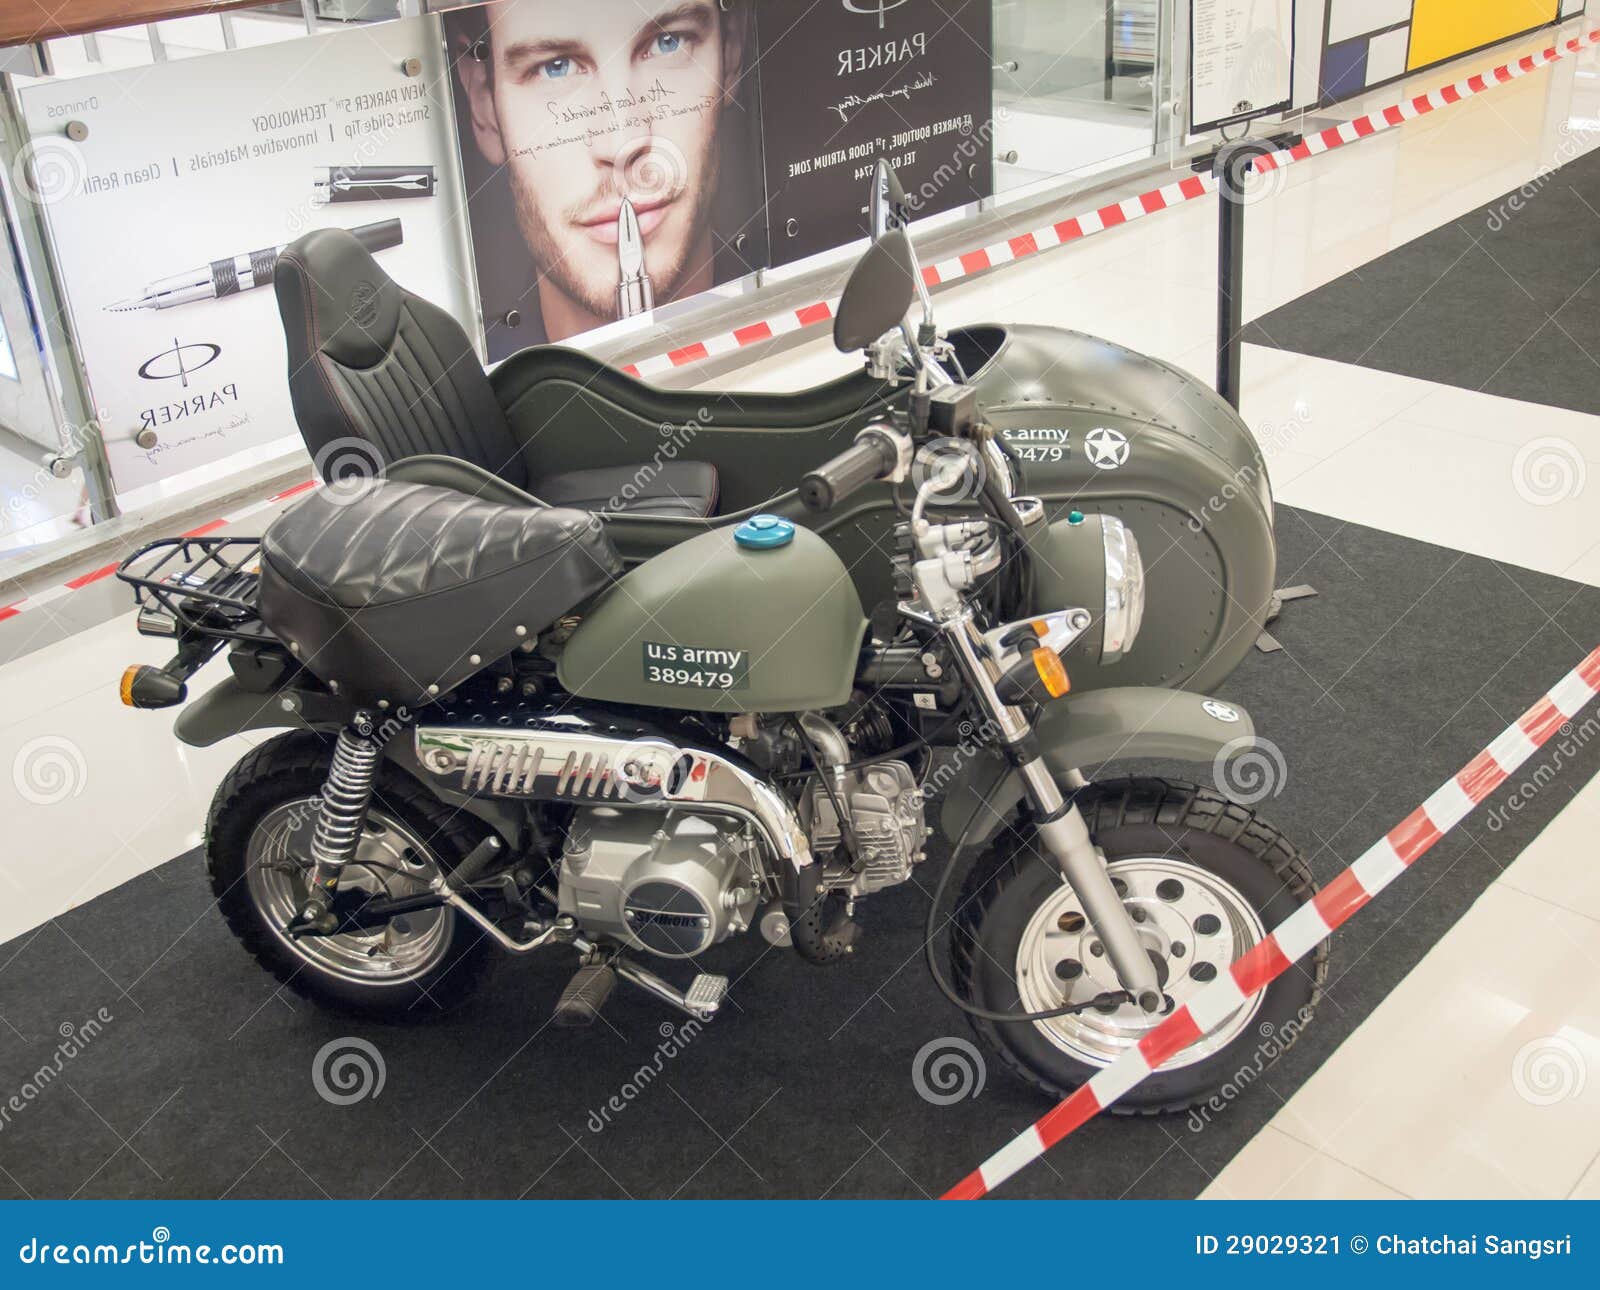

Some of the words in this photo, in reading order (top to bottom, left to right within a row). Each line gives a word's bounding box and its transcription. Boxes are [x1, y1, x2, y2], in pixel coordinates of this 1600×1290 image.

[1017, 428, 1070, 444] army
[1008, 448, 1063, 462] 479
[647, 644, 677, 661] u.s
[683, 648, 741, 669] army
[649, 666, 733, 688] 389479
